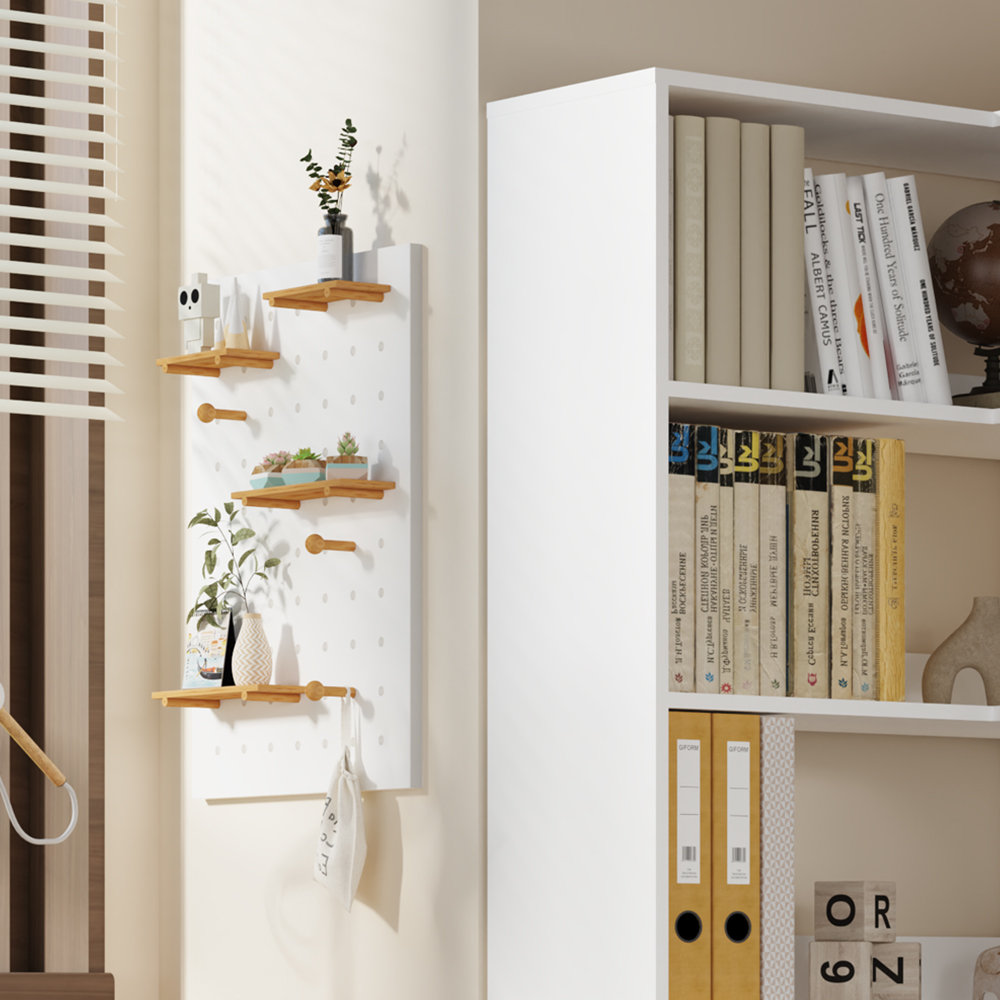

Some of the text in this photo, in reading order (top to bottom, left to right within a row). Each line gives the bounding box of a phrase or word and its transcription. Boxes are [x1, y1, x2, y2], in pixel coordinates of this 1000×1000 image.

[804, 189, 817, 234] FALL
[903, 183, 912, 204] GABRIEL
[815, 184, 829, 255] Goldilocks
[853, 203, 866, 244] LAST TICK
[825, 259, 831, 269] &
[874, 193, 909, 342] One Hundred Years of Solitude
[811, 252, 832, 346] ALBERT CAMUS
[826, 274, 834, 295] the
[830, 300, 839, 333] three
[920, 290, 930, 315] HUNDRED
[925, 315, 934, 332] YEARS
[930, 342, 940, 367] SOLITUDE
[835, 338, 845, 374] Bears
[826, 894, 855, 927] O
[875, 895, 891, 928] R
